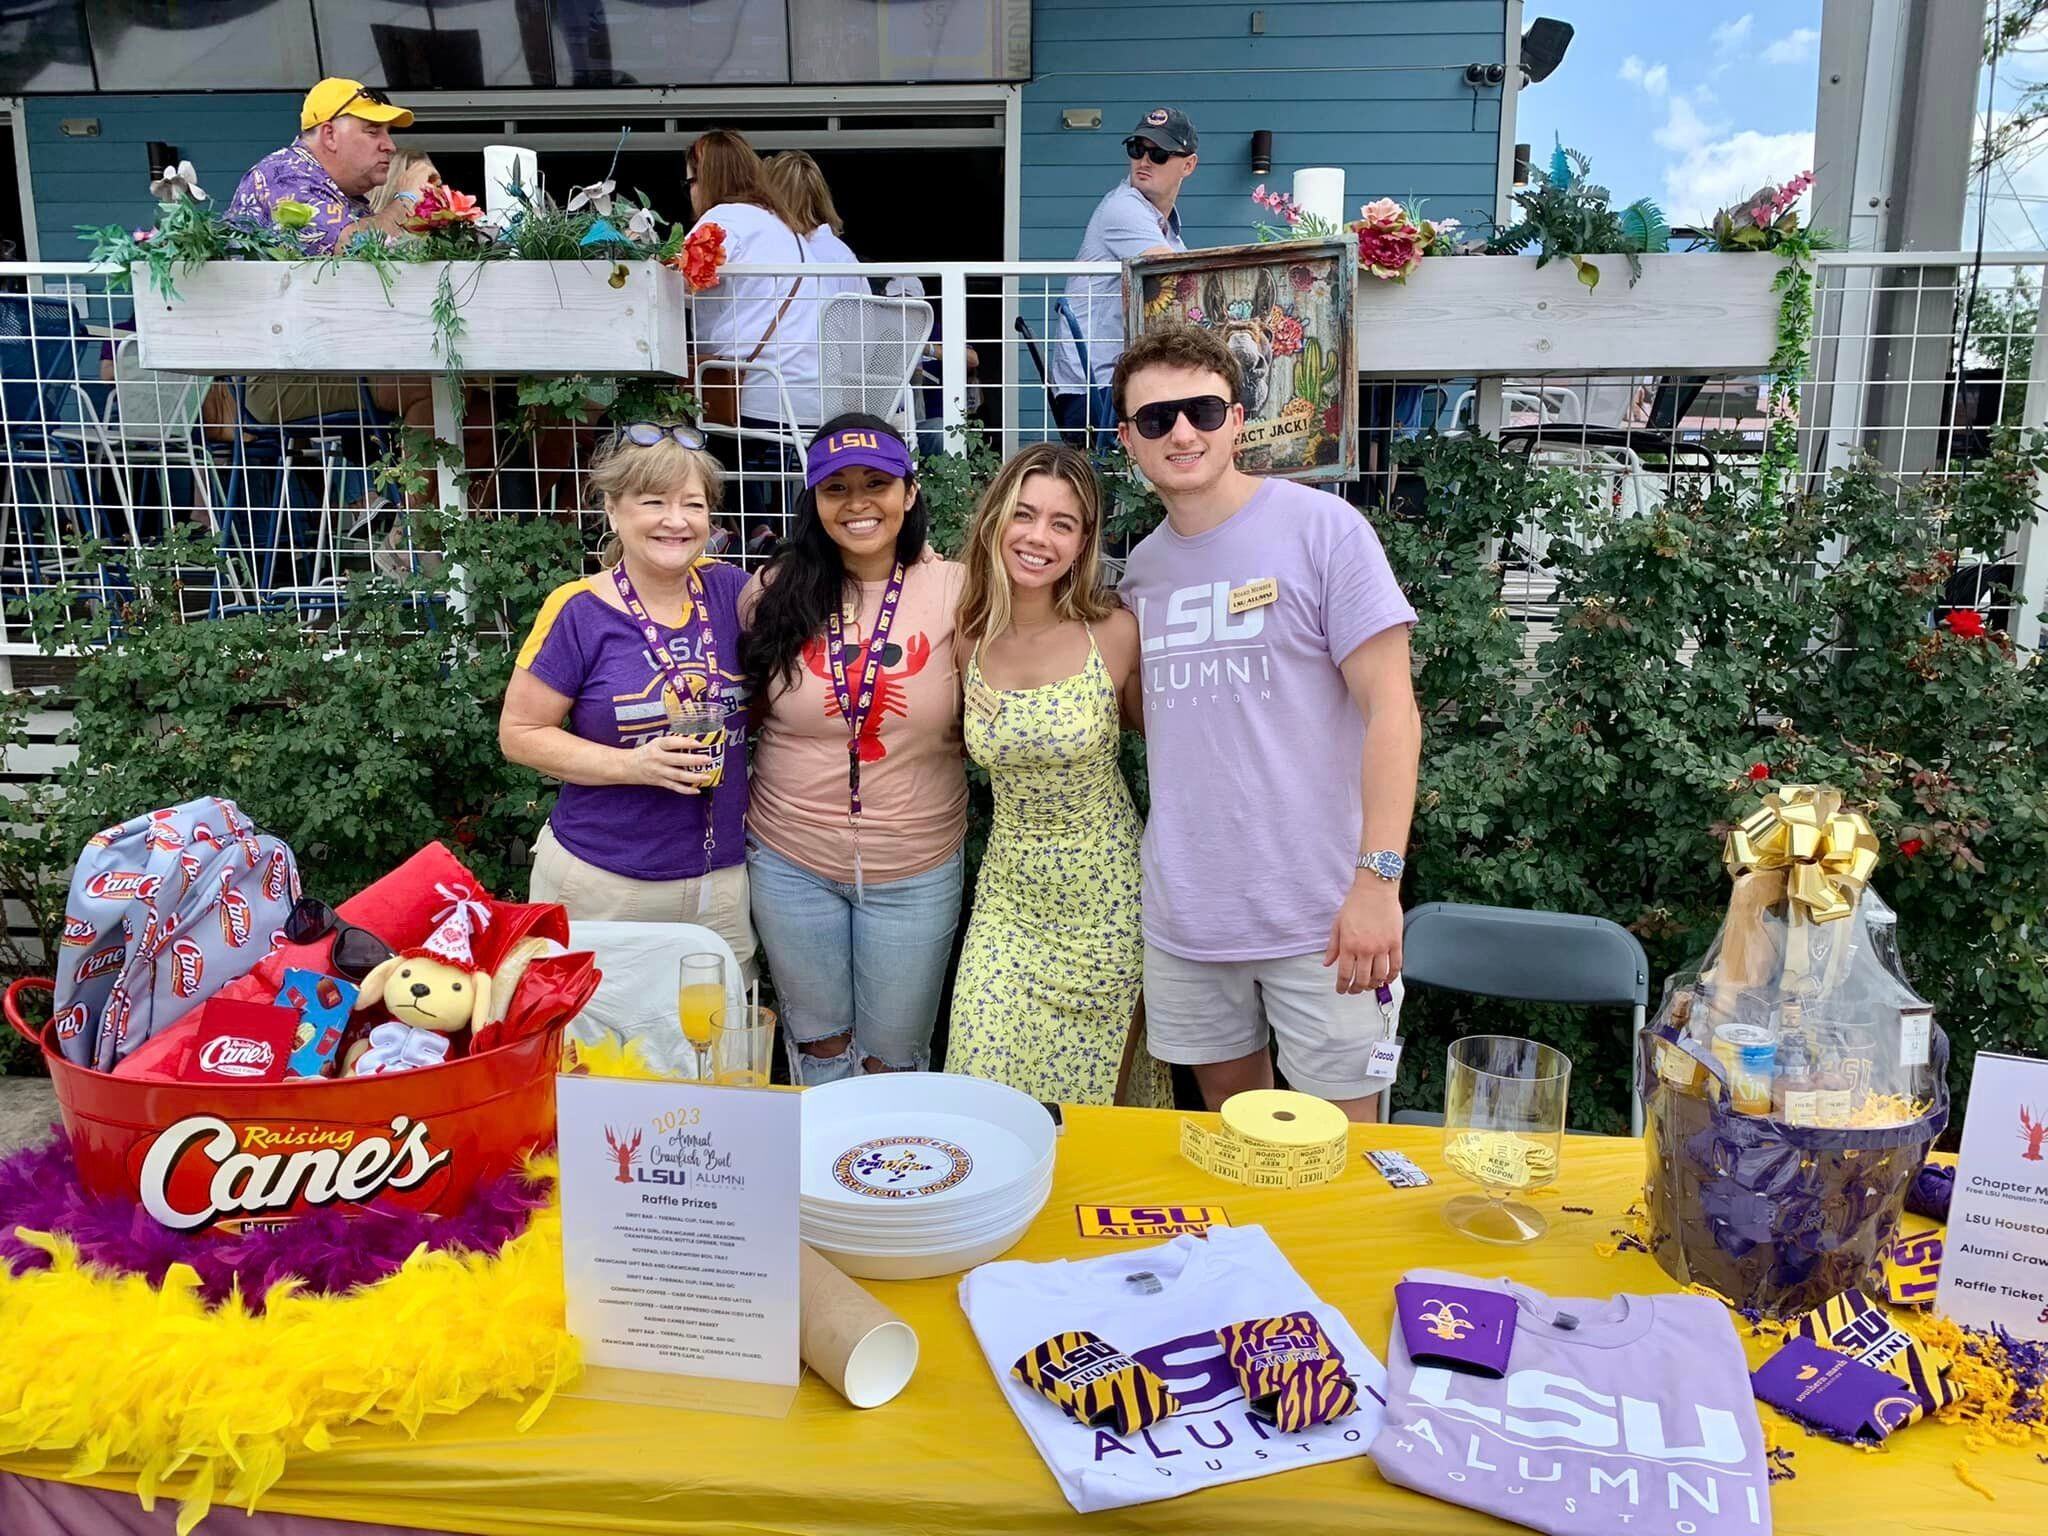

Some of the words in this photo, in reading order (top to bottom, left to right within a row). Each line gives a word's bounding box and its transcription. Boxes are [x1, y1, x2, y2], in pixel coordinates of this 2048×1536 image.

[1270, 418, 1308, 438] JACK!
[829, 433, 878, 454] LSU
[1137, 577, 1265, 653] LSU
[1144, 655, 1270, 694] LUMNI
[1150, 690, 1271, 711] OUSTON
[223, 890, 251, 948] Cane's
[173, 939, 202, 999] Cane's
[201, 1036, 271, 1071] Cane's
[652, 1107, 701, 1134] 2023
[242, 1126, 355, 1150] Raising
[669, 1128, 713, 1147] Annual
[1214, 1140, 1242, 1153] COUPON
[650, 1145, 702, 1167] Crawfish
[703, 1149, 732, 1170] Boil
[1218, 1151, 1236, 1160] KEEP
[1255, 1150, 1286, 1159] COUPON
[1300, 1148, 1326, 1158] COUPON
[1304, 1157, 1322, 1165] KEEP
[1488, 1157, 1510, 1167] KEEP
[140, 1115, 449, 1229] Cane's
[637, 1167, 686, 1186] LSU
[696, 1172, 745, 1186] ALUMNI
[1214, 1163, 1240, 1180] TICKET
[1255, 1173, 1284, 1186] TICKET
[1299, 1171, 1324, 1185] TICKET
[1480, 1164, 1513, 1179] COUPON
[1966, 1186, 1984, 1196] Free
[1985, 1189, 2001, 1198] LSU
[2002, 1193, 2037, 1204] Houston
[1972, 1175, 2032, 1195] Chapter
[642, 1194, 679, 1206] Raffle
[682, 1197, 718, 1209] Prizes
[1096, 1207, 1210, 1226] LSU
[1965, 1213, 1991, 1225] LSU
[1100, 1224, 1213, 1236] ALUMN
[1960, 1243, 2009, 1260] Alumni
[1954, 1278, 1997, 1294] Raffle
[2001, 1285, 2044, 1303] Ticket
[1831, 1310, 1891, 1351] SU
[1242, 1334, 1318, 1358] LSU
[1040, 1341, 1120, 1381] LSU
[1069, 1356, 1138, 1391] ALUMNI
[1409, 1366, 1747, 1464] LSU
[1404, 1418, 1761, 1525] ALUMNI
[1396, 1438, 1697, 1535] HOUSTO
